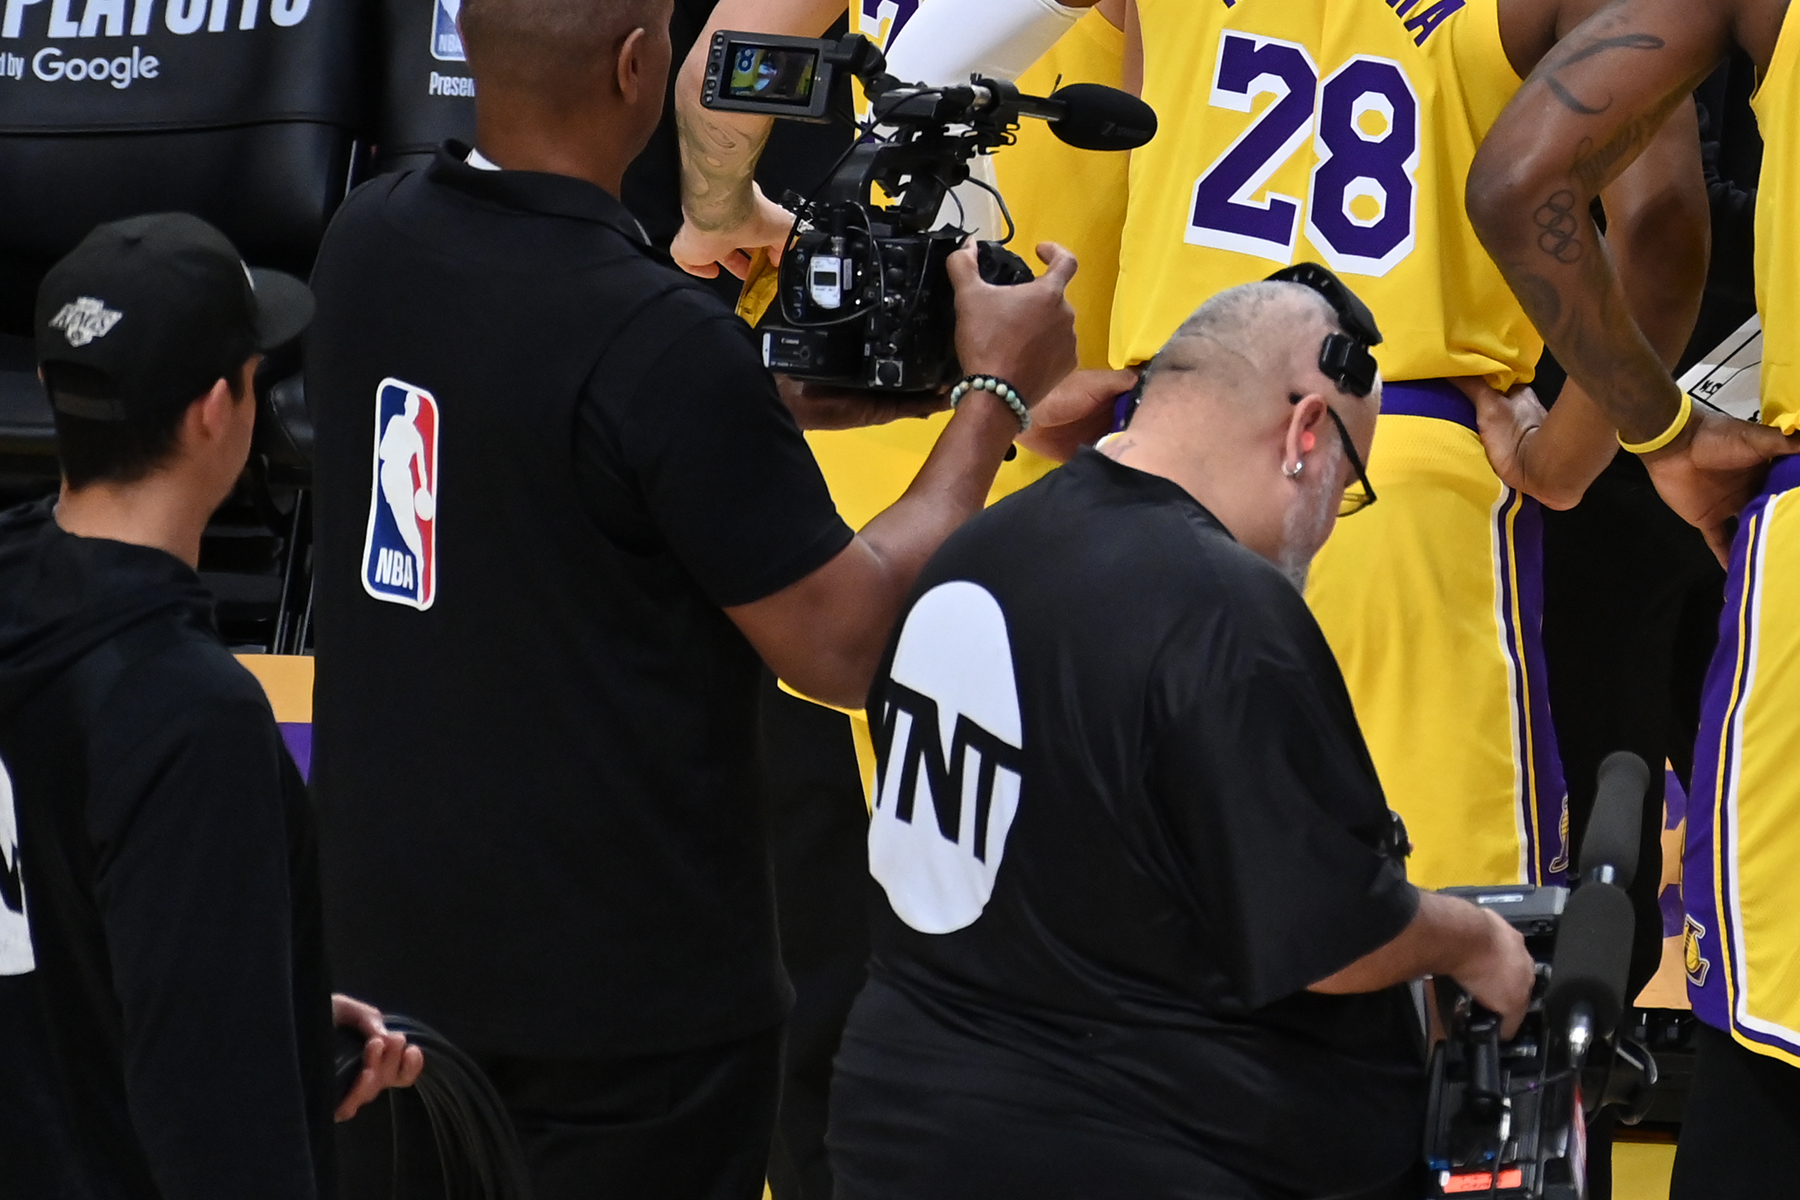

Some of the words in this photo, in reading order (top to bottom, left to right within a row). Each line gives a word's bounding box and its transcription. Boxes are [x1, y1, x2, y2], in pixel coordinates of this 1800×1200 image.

[8, 52, 25, 81] by
[32, 46, 160, 89] Google
[1184, 29, 1421, 277] 28
[375, 547, 414, 591] NBA
